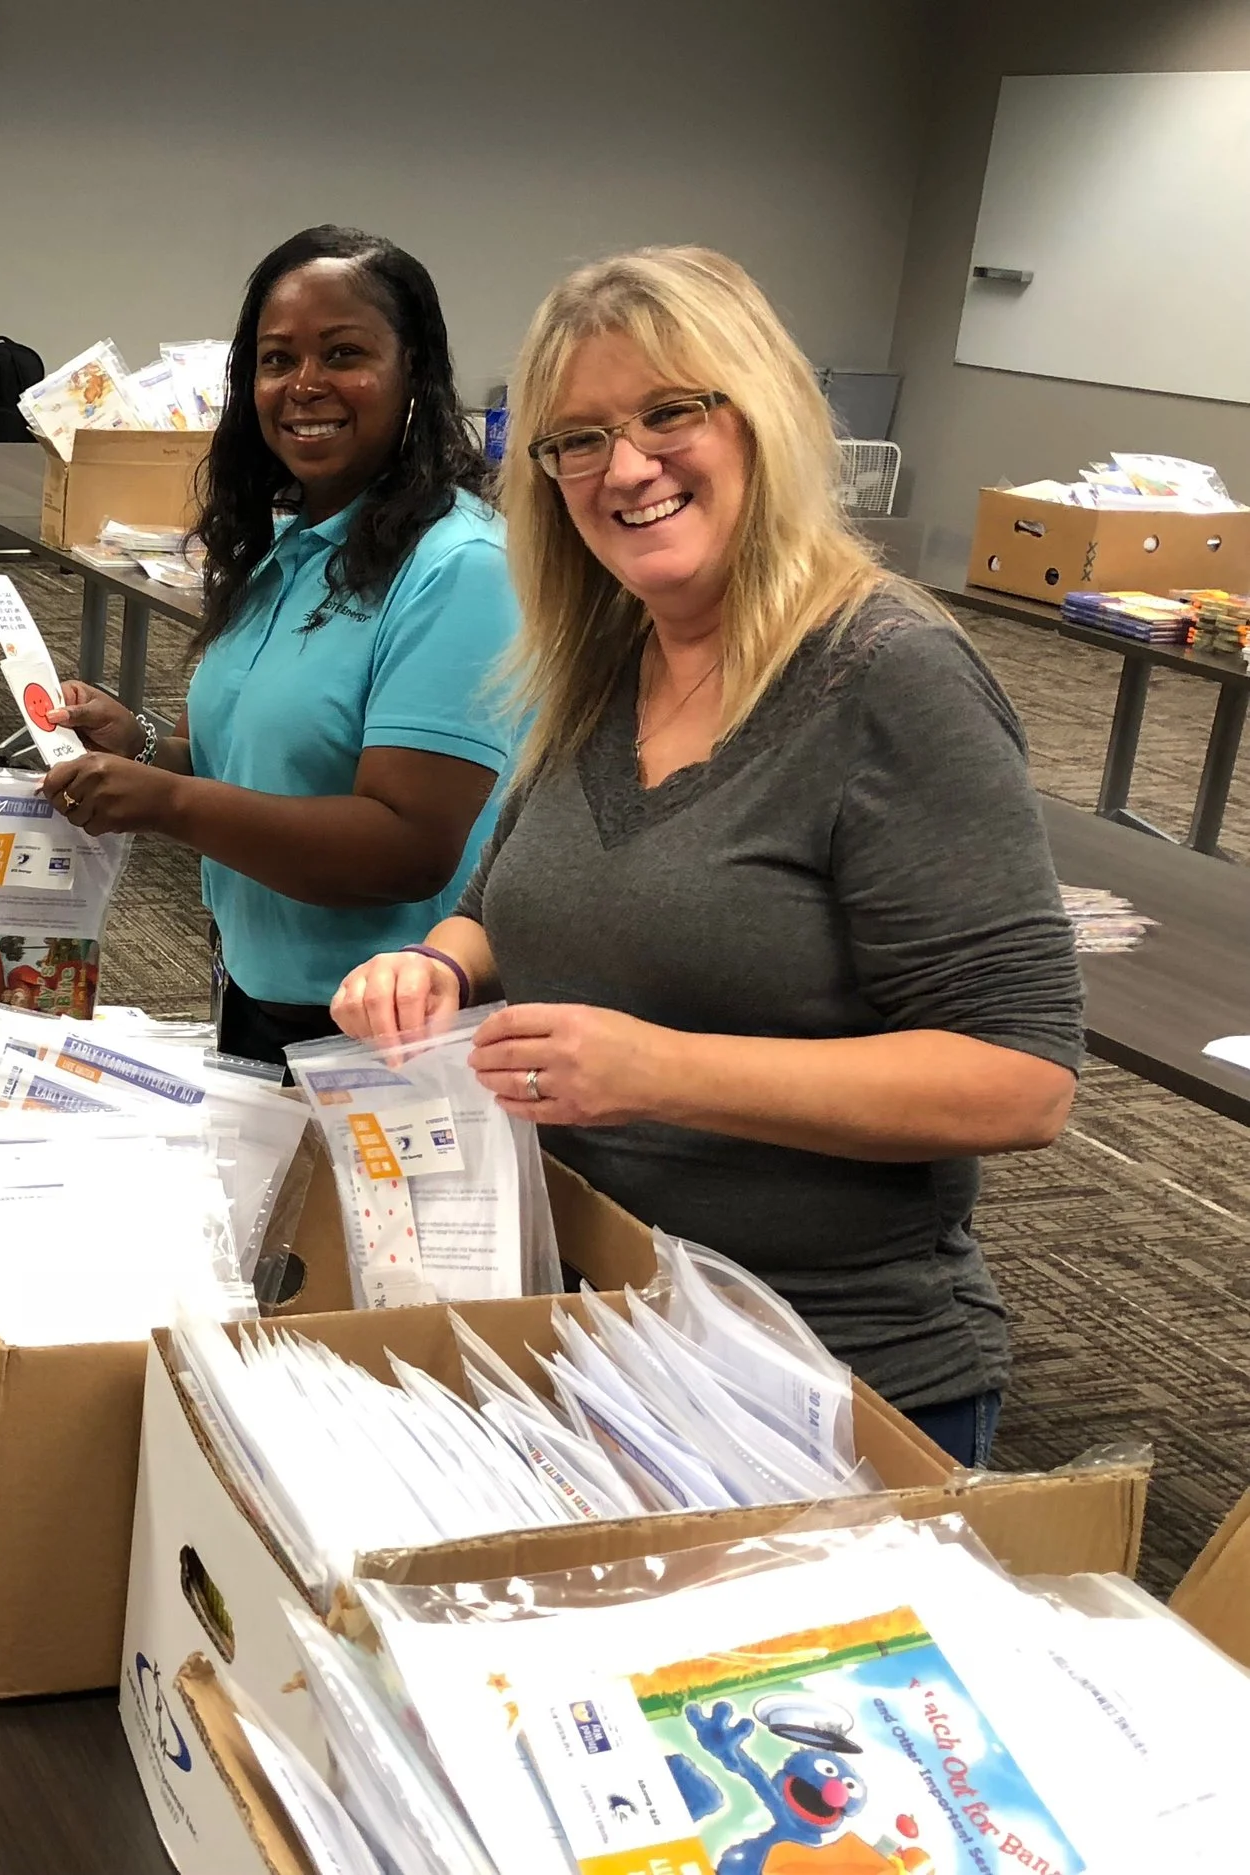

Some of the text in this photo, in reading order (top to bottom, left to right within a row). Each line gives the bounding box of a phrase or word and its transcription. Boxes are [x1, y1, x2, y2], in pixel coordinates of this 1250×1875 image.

[340, 606, 371, 622] Energy
[53, 745, 74, 758] circle
[36, 803, 50, 814] KIT
[71, 1040, 198, 1103] EARLY LEARNER LITERACY KIT
[809, 1388, 820, 1407] 30
[578, 1724, 600, 1754] United
[589, 1723, 605, 1741] Way
[873, 1698, 898, 1723] and
[891, 1725, 924, 1766] Other
[919, 1768, 974, 1844] Important
[942, 1756, 979, 1799] Out
[961, 1801, 1000, 1836] for
